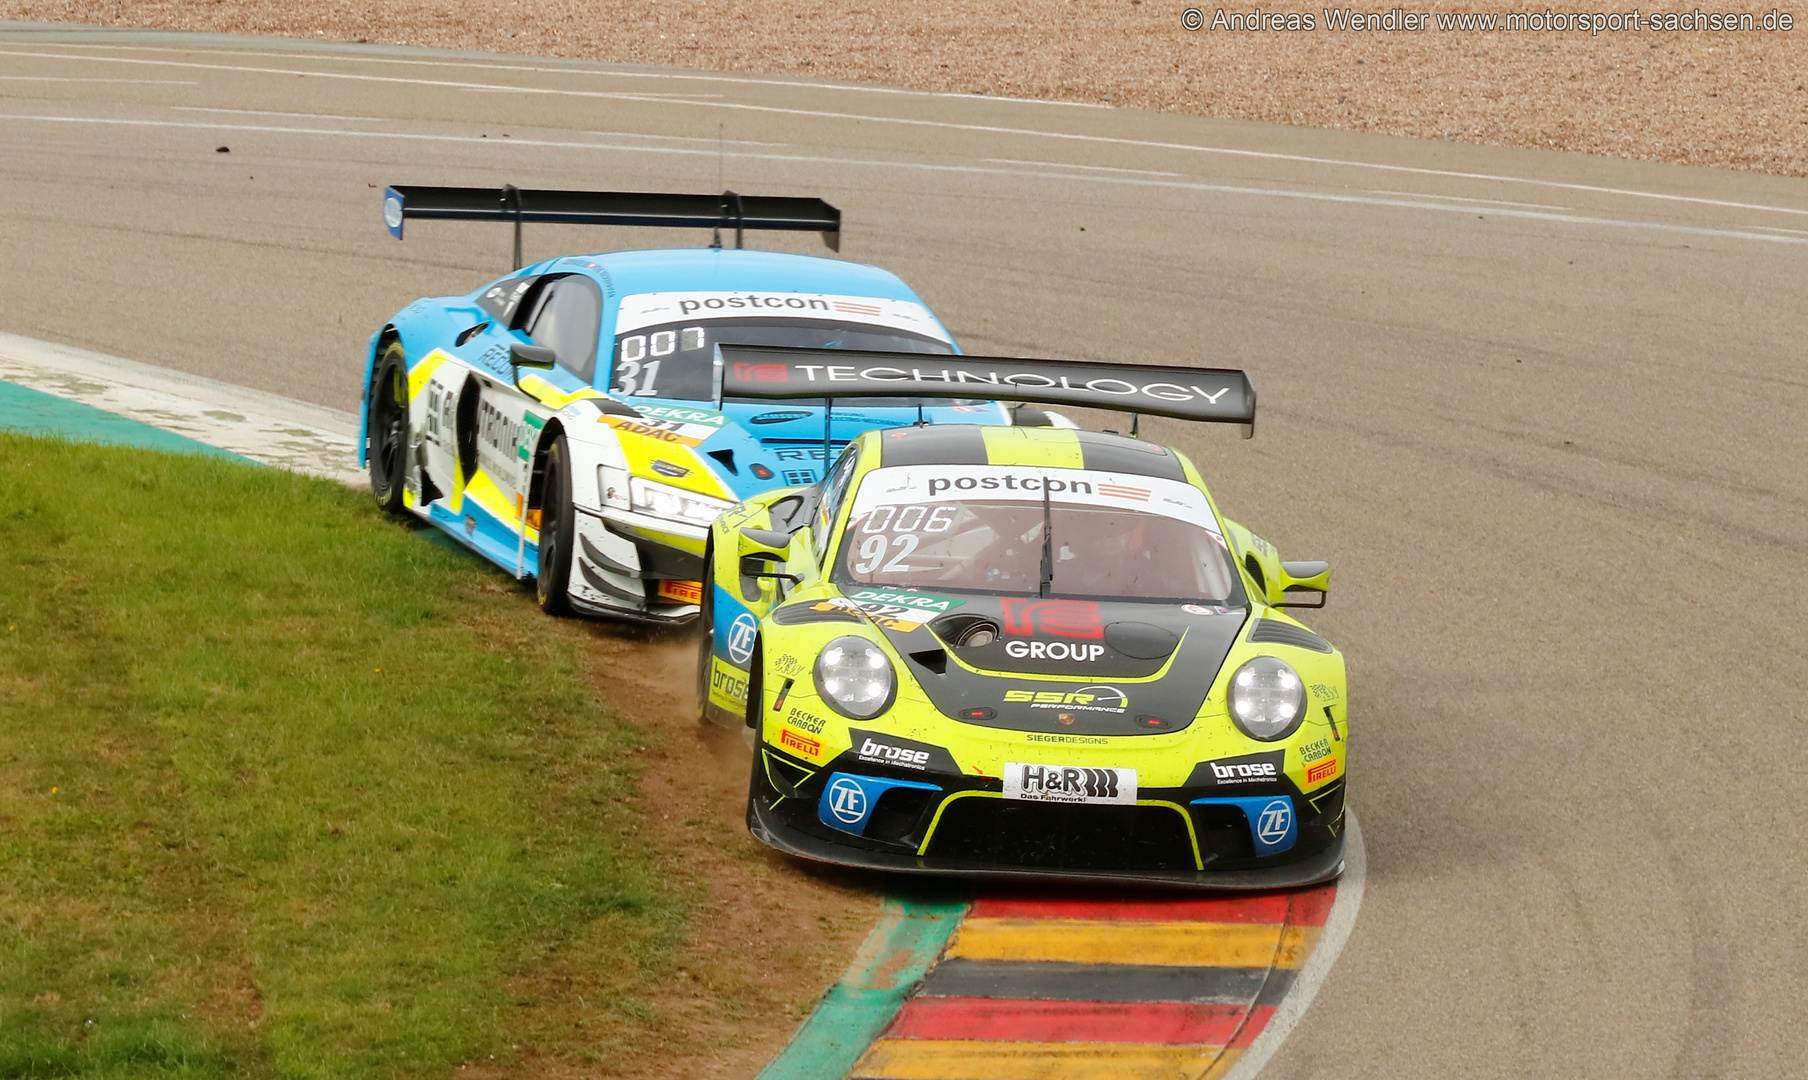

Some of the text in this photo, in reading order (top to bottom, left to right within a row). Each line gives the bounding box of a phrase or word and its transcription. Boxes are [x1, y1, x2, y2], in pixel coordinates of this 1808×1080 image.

[679, 295, 830, 315] postcon
[609, 361, 661, 396] 31
[795, 364, 1231, 406] TECHNOLOGY
[632, 404, 726, 425] DEKRA
[614, 421, 681, 442] ADAC
[928, 474, 1092, 496] postcon
[862, 505, 957, 534] 006
[855, 534, 919, 574] 92
[665, 580, 702, 600] PIRE
[852, 590, 951, 611] DEKRA
[860, 603, 909, 619] 92
[1005, 640, 1105, 662] GROUP
[1003, 689, 1096, 706] SSR
[1030, 702, 1127, 714] PERFORMANCE
[786, 715, 823, 736] CARBON
[789, 707, 827, 728] BECKER
[781, 728, 821, 757] PIRELLI
[1026, 734, 1109, 745] SIEGERDESIGNS
[1299, 738, 1329, 755] BECKER
[860, 737, 930, 764] brose
[1303, 747, 1332, 763] CARBON
[1022, 765, 1083, 795] H&R
[1209, 761, 1277, 778] brose
[1307, 758, 1337, 784] PIRELLI
[831, 784, 865, 818] ZF
[1259, 806, 1290, 839] ZF
